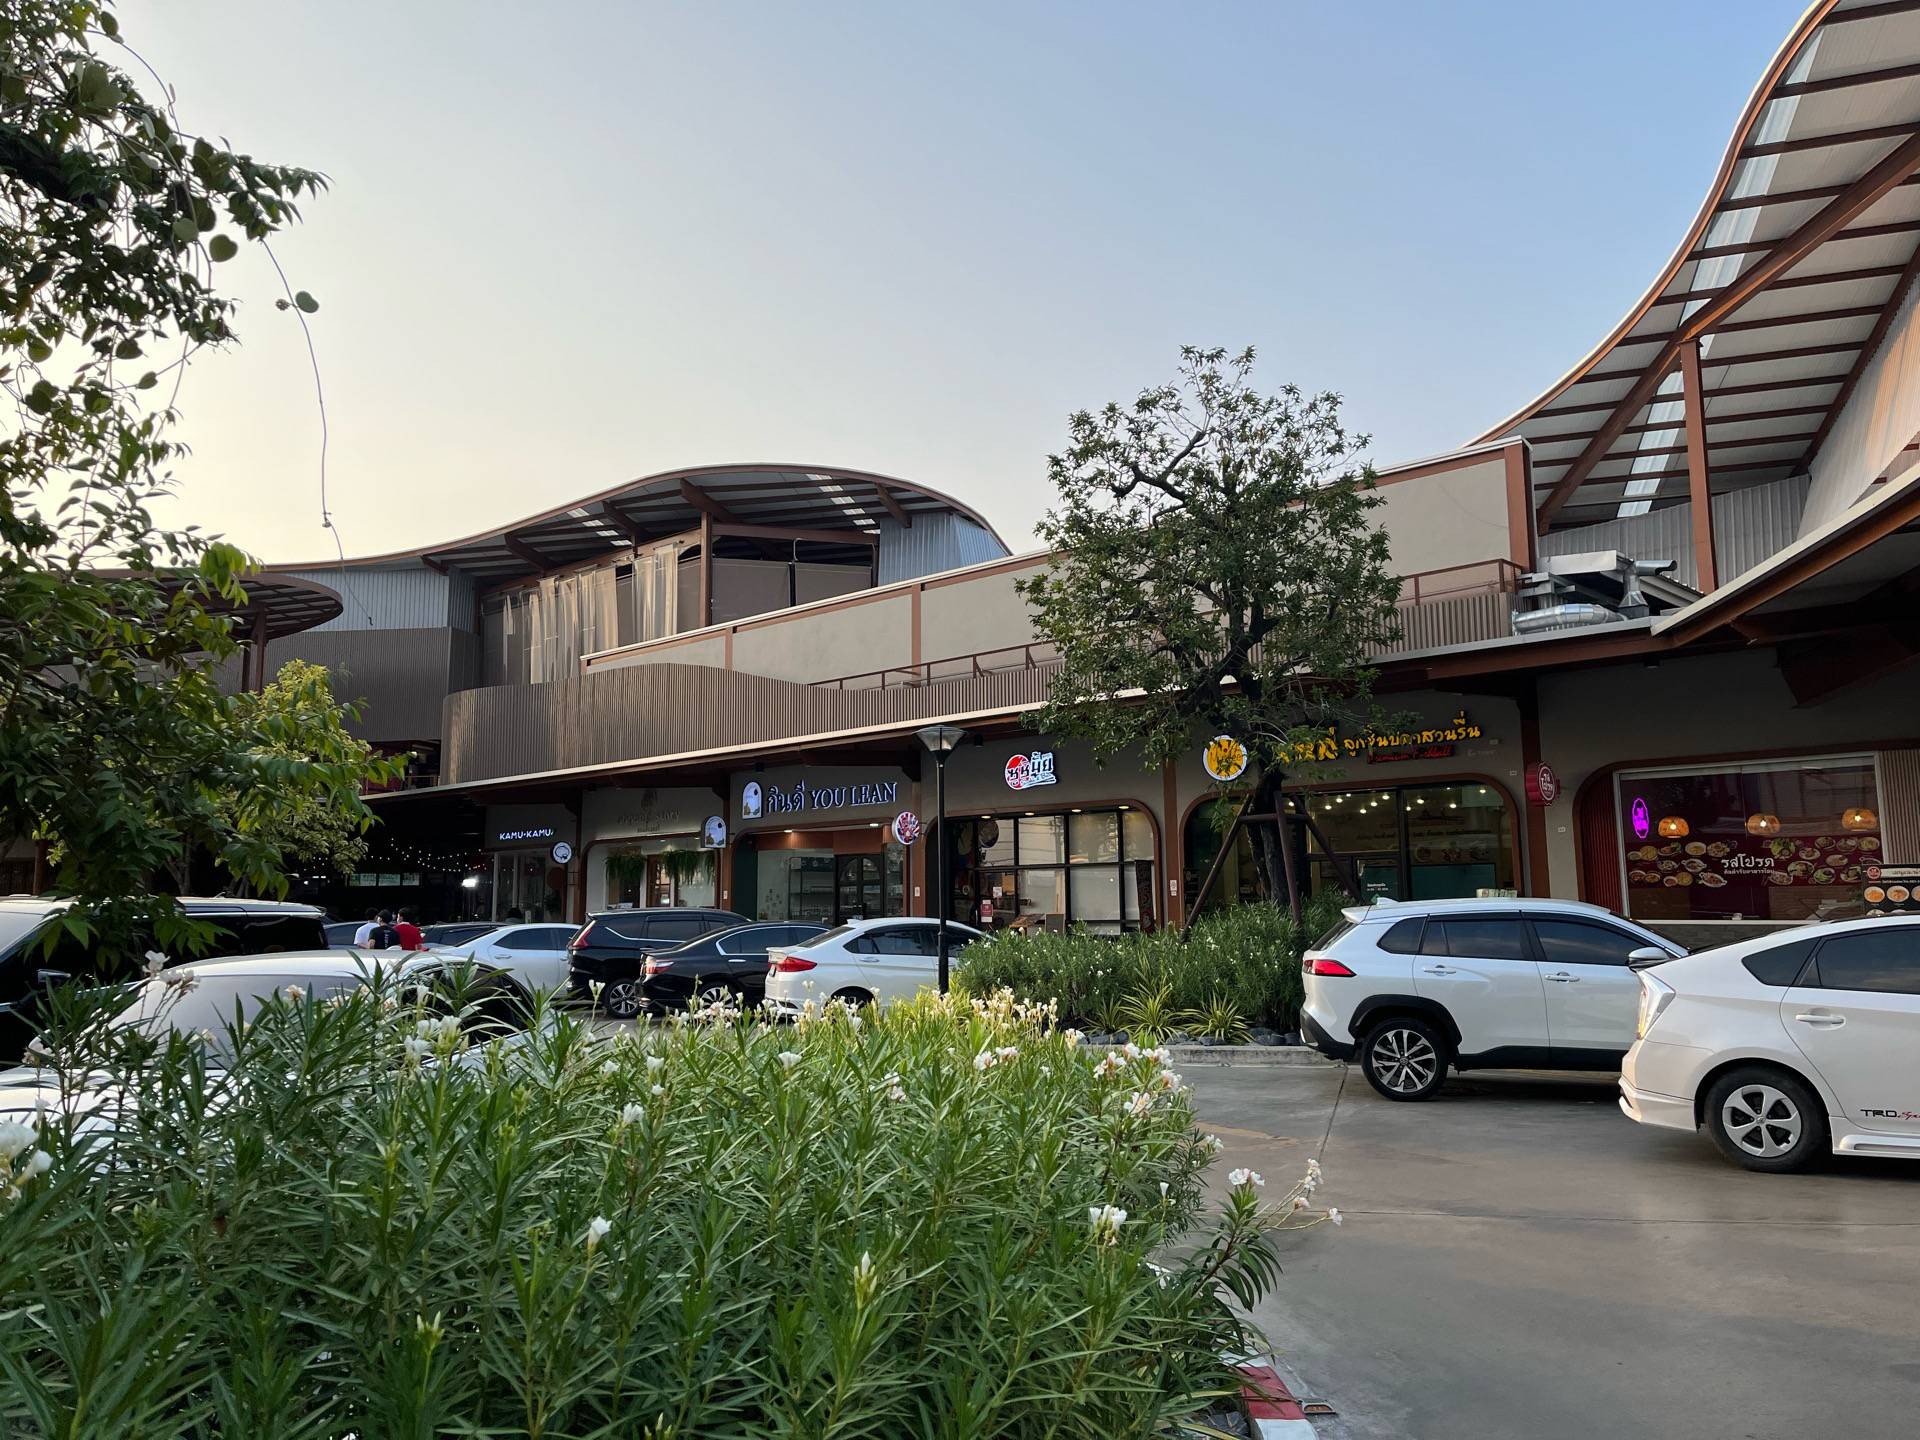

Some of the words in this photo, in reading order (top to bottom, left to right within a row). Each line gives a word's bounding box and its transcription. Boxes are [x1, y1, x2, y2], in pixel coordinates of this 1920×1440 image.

[810, 786, 847, 810] YOU
[850, 782, 898, 807] LEAN
[1721, 853, 1775, 868] รสโปรด
[1860, 1109, 1897, 1118] TRD
